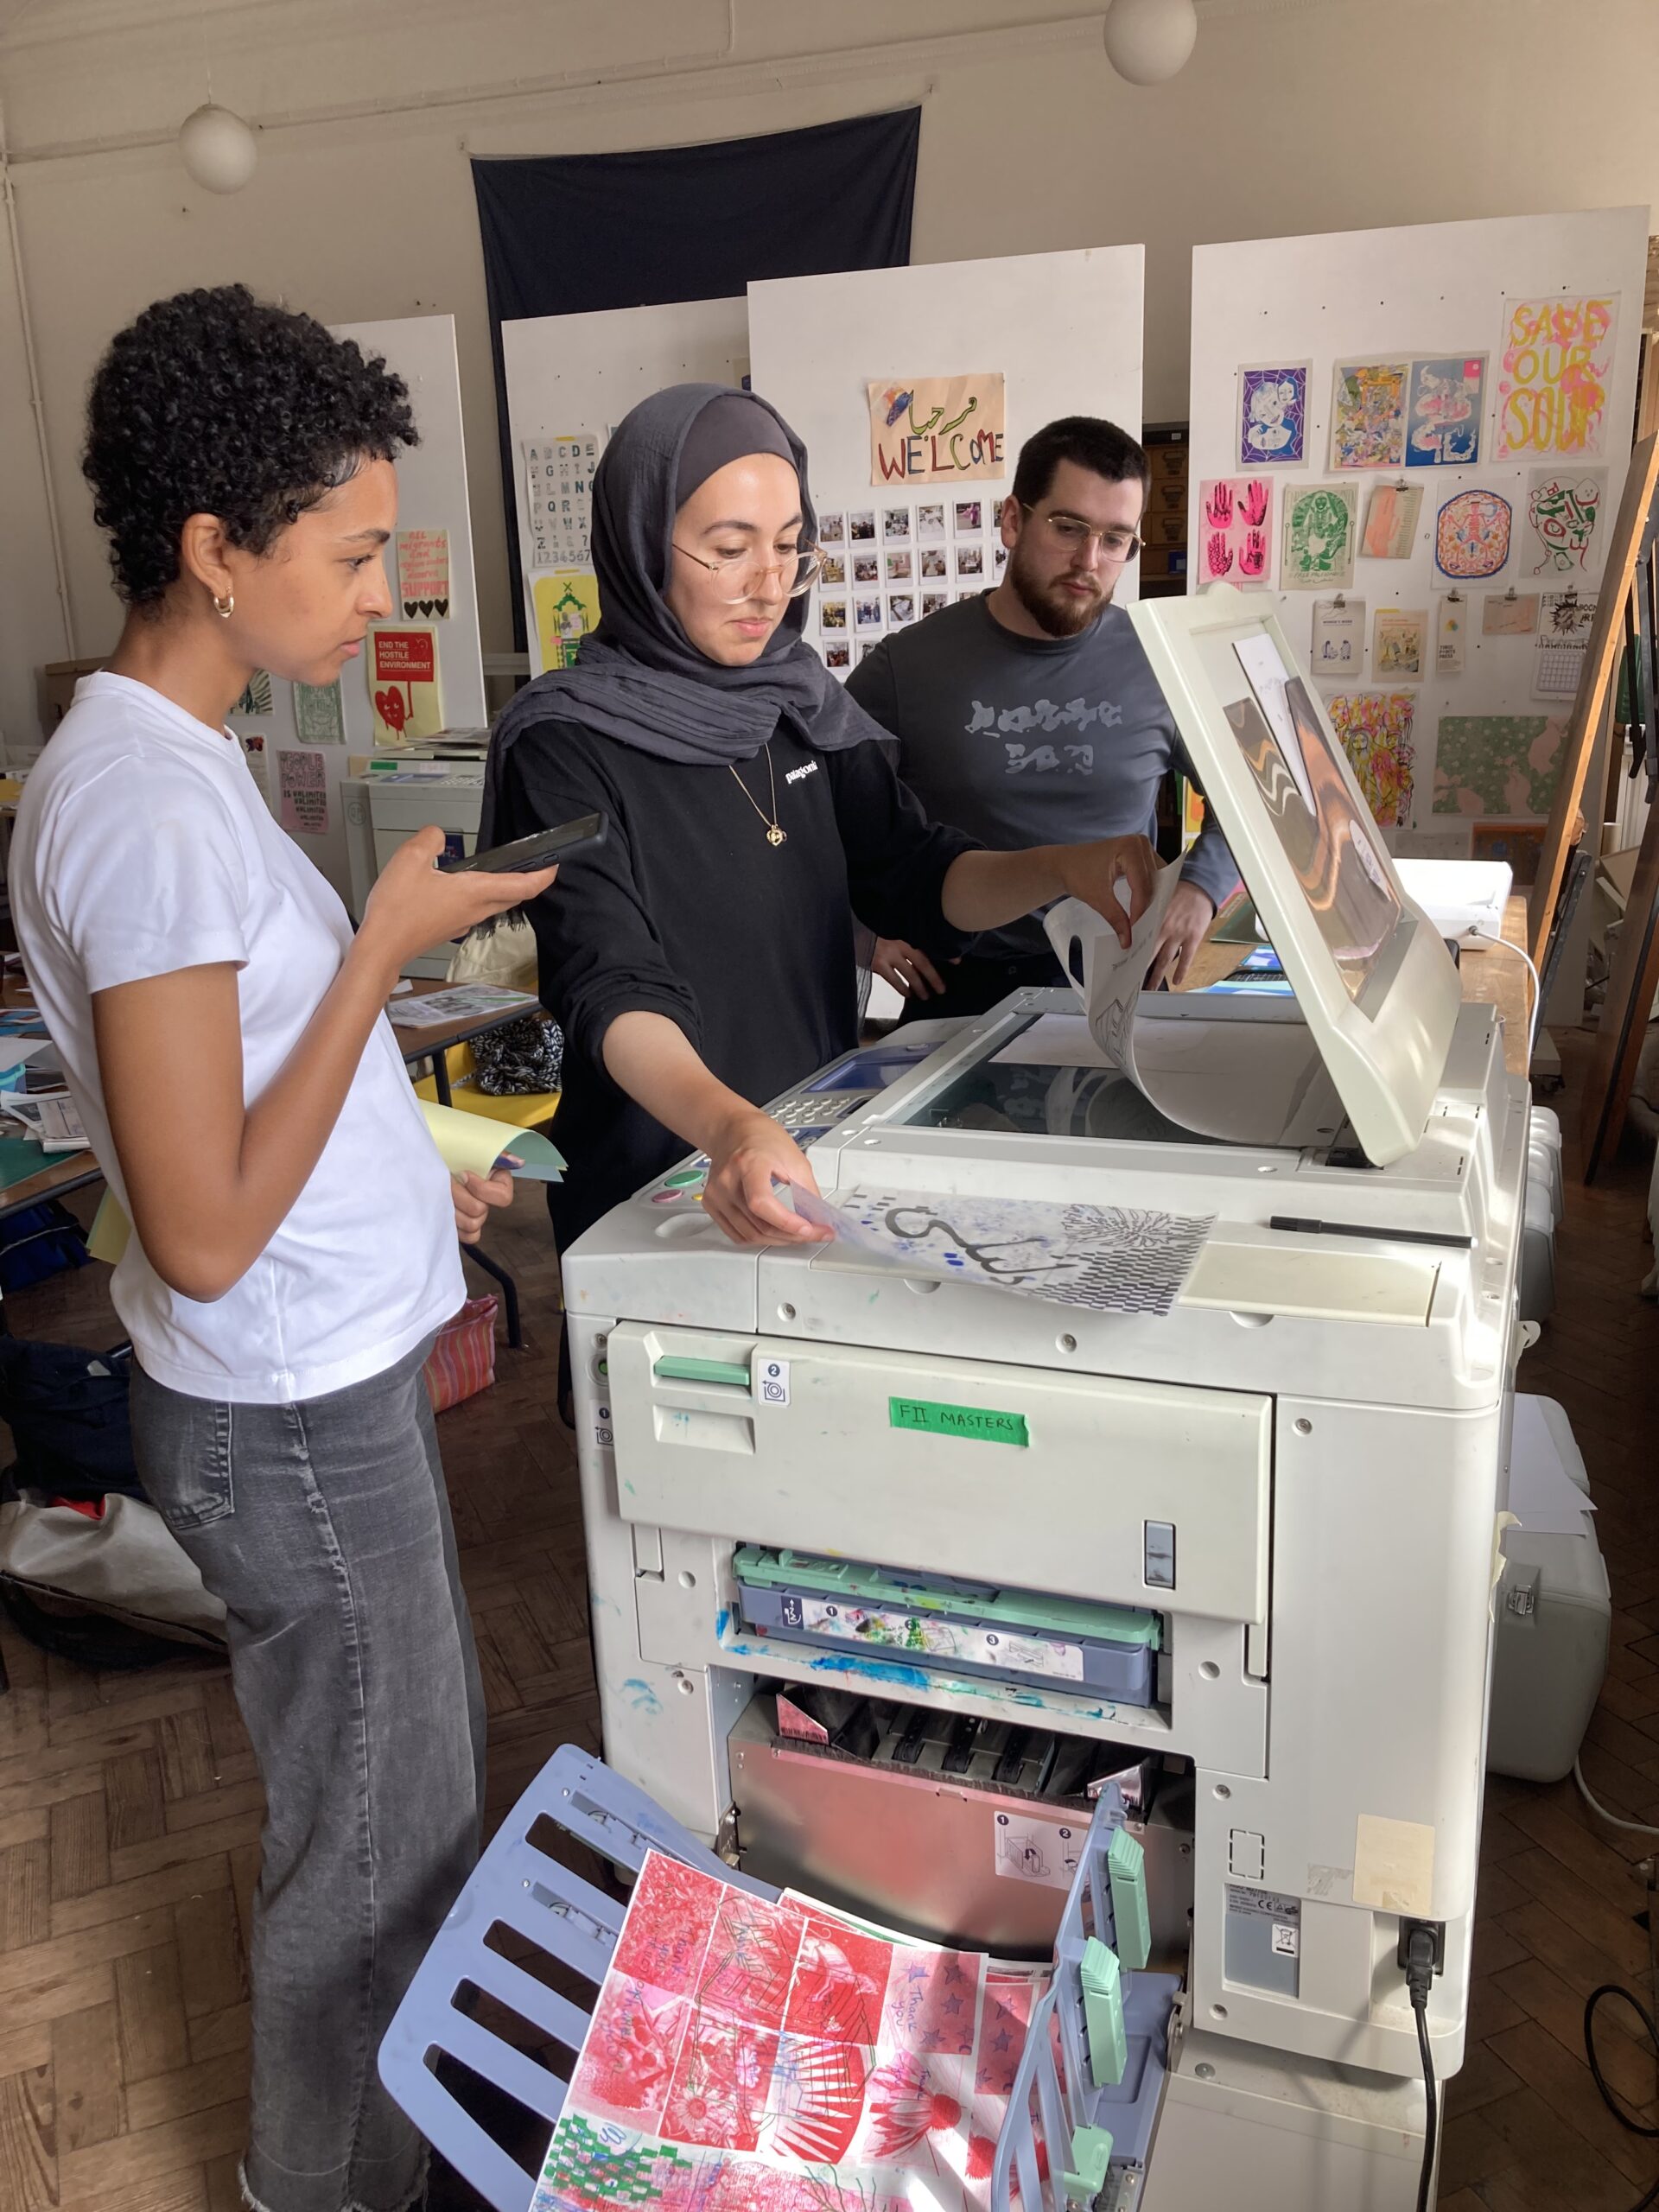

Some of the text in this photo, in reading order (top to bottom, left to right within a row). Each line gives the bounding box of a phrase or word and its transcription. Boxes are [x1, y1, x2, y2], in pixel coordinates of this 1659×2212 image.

[1511, 299, 1613, 346] SAVE
[1513, 346, 1596, 385] OUR
[1505, 382, 1605, 451] SOUP
[878, 429, 1004, 480] WELCOME
[400, 580, 449, 597] SUPPORT
[378, 640, 394, 649] END
[379, 651, 410, 659] HOSTILE
[379, 660, 431, 670] ENVIRONMENT
[279, 751, 325, 772] PEOPLE
[785, 760, 818, 784] patagonia
[281, 771, 327, 789] POWER
[283, 789, 292, 798] IS
[940, 1412, 1014, 1431] MASTERS
[892, 2000, 905, 2026] you
[907, 1985, 924, 2032] Thank
[916, 2068, 931, 2101] Thank
